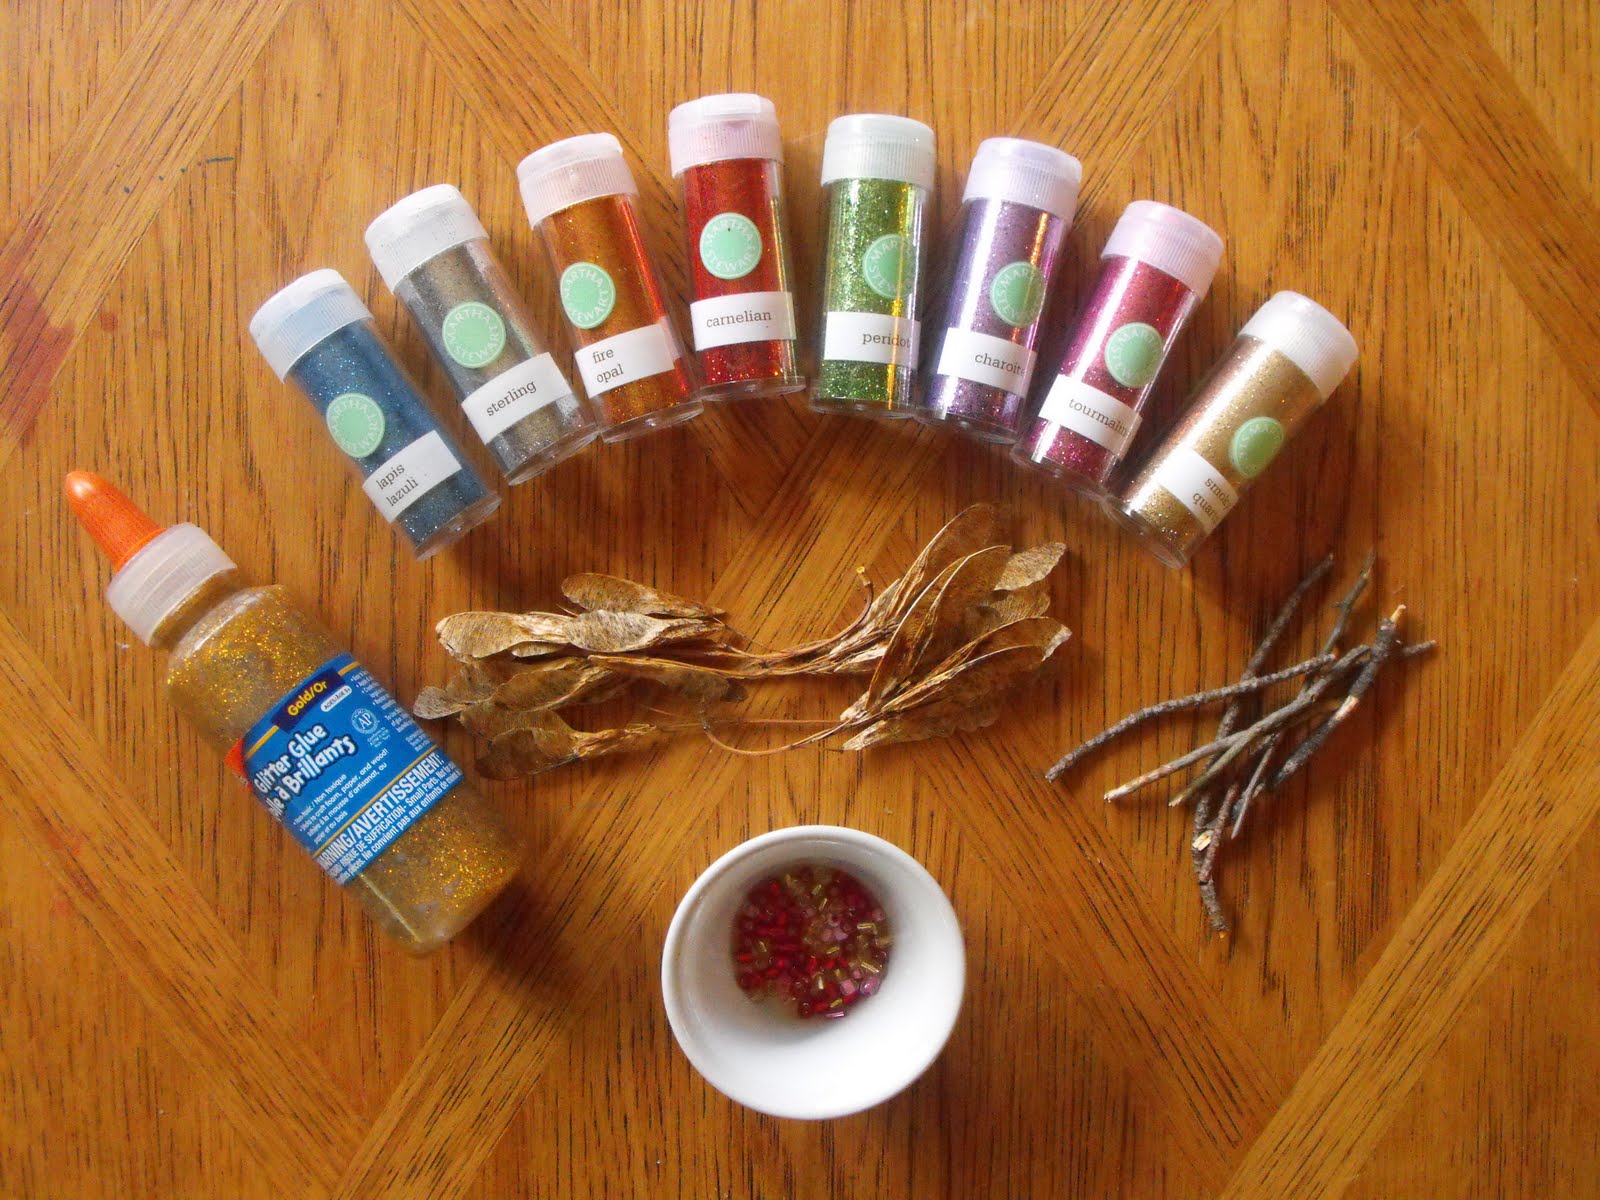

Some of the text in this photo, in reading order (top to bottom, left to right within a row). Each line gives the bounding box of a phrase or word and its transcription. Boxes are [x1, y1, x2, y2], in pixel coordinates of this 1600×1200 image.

[706, 310, 772, 328] carnelian
[862, 333, 911, 348] peridot
[592, 349, 614, 364] fire
[596, 363, 624, 383] opal
[486, 381, 537, 416] sterling
[1068, 399, 1130, 437] tourmalin
[375, 464, 405, 489] lapis
[386, 476, 419, 506] lazuli
[1193, 492, 1219, 520] quar
[287, 680, 327, 716] Gold/Or
[254, 725, 327, 793] Glitter Glue
[281, 736, 356, 794] Brillants
[359, 762, 372, 776] and
[313, 793, 326, 805] Non
[325, 774, 347, 793] toxique
[355, 840, 368, 852] DE
[405, 787, 425, 806] Small
[361, 850, 373, 860] Ne
[371, 825, 400, 853] convient
[396, 815, 411, 831] pas
[408, 805, 423, 819] aux
[420, 786, 443, 808] enfants
